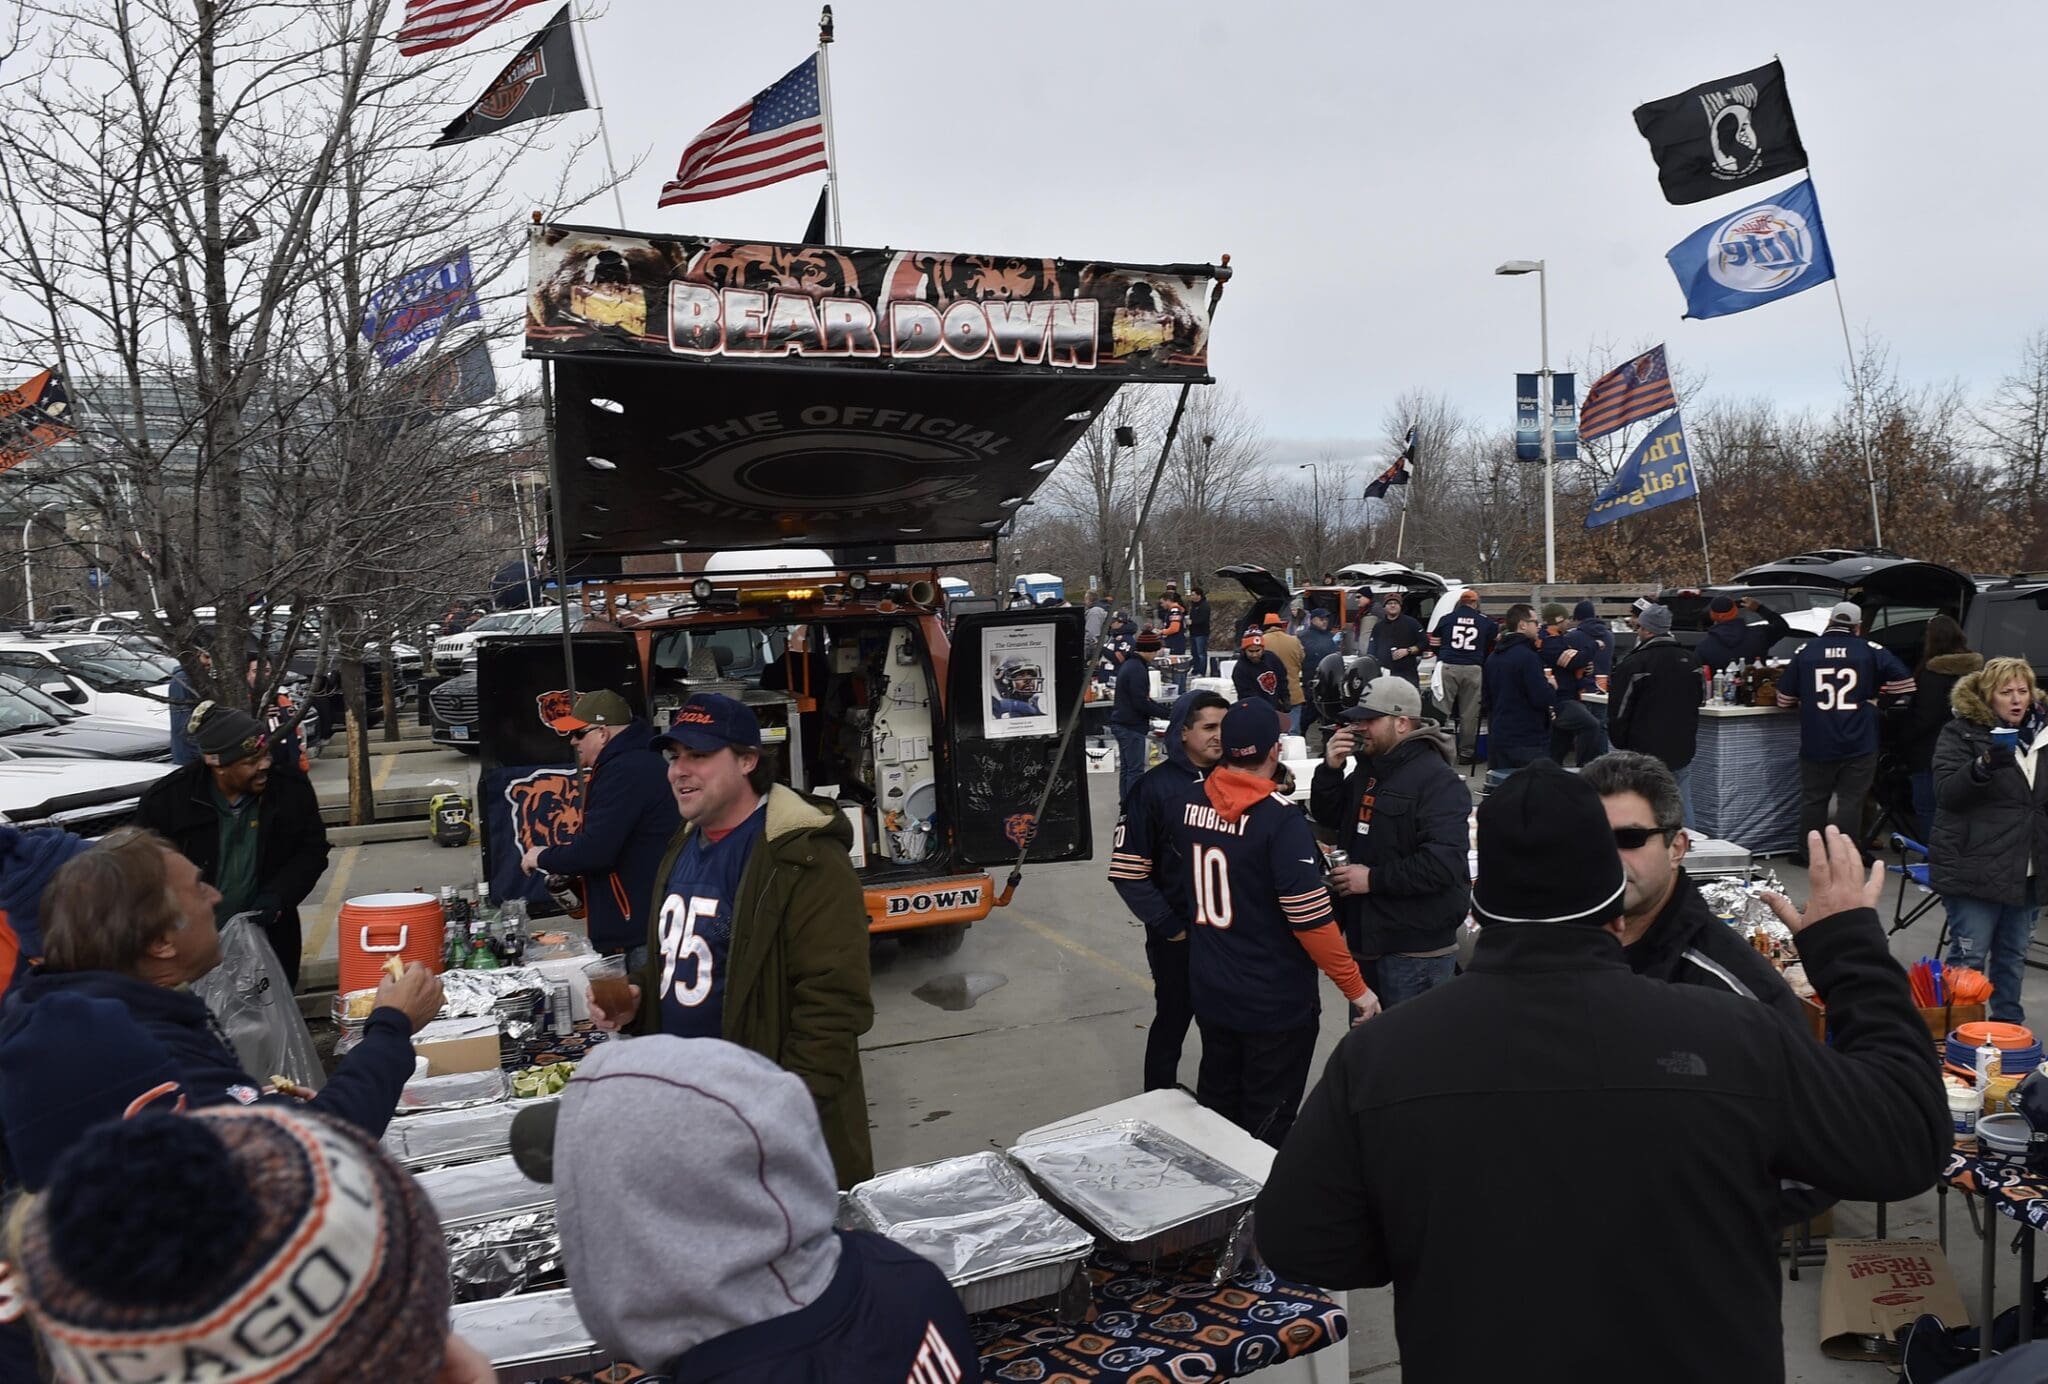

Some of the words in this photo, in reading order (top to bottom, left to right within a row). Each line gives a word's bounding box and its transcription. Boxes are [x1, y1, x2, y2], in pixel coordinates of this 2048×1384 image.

[667, 279, 882, 359] BEAR
[890, 298, 1100, 370] DOWN
[667, 409, 785, 451] THE
[800, 405, 1013, 456] OFFICIAL
[1451, 625, 1479, 650] 52
[1815, 668, 1858, 710] 52
[888, 888, 980, 915] DOWN
[1192, 842, 1233, 930] 10
[658, 893, 720, 1007] 95
[1846, 1257, 1933, 1280] FRESH!
[1889, 1271, 1936, 1289] GET
